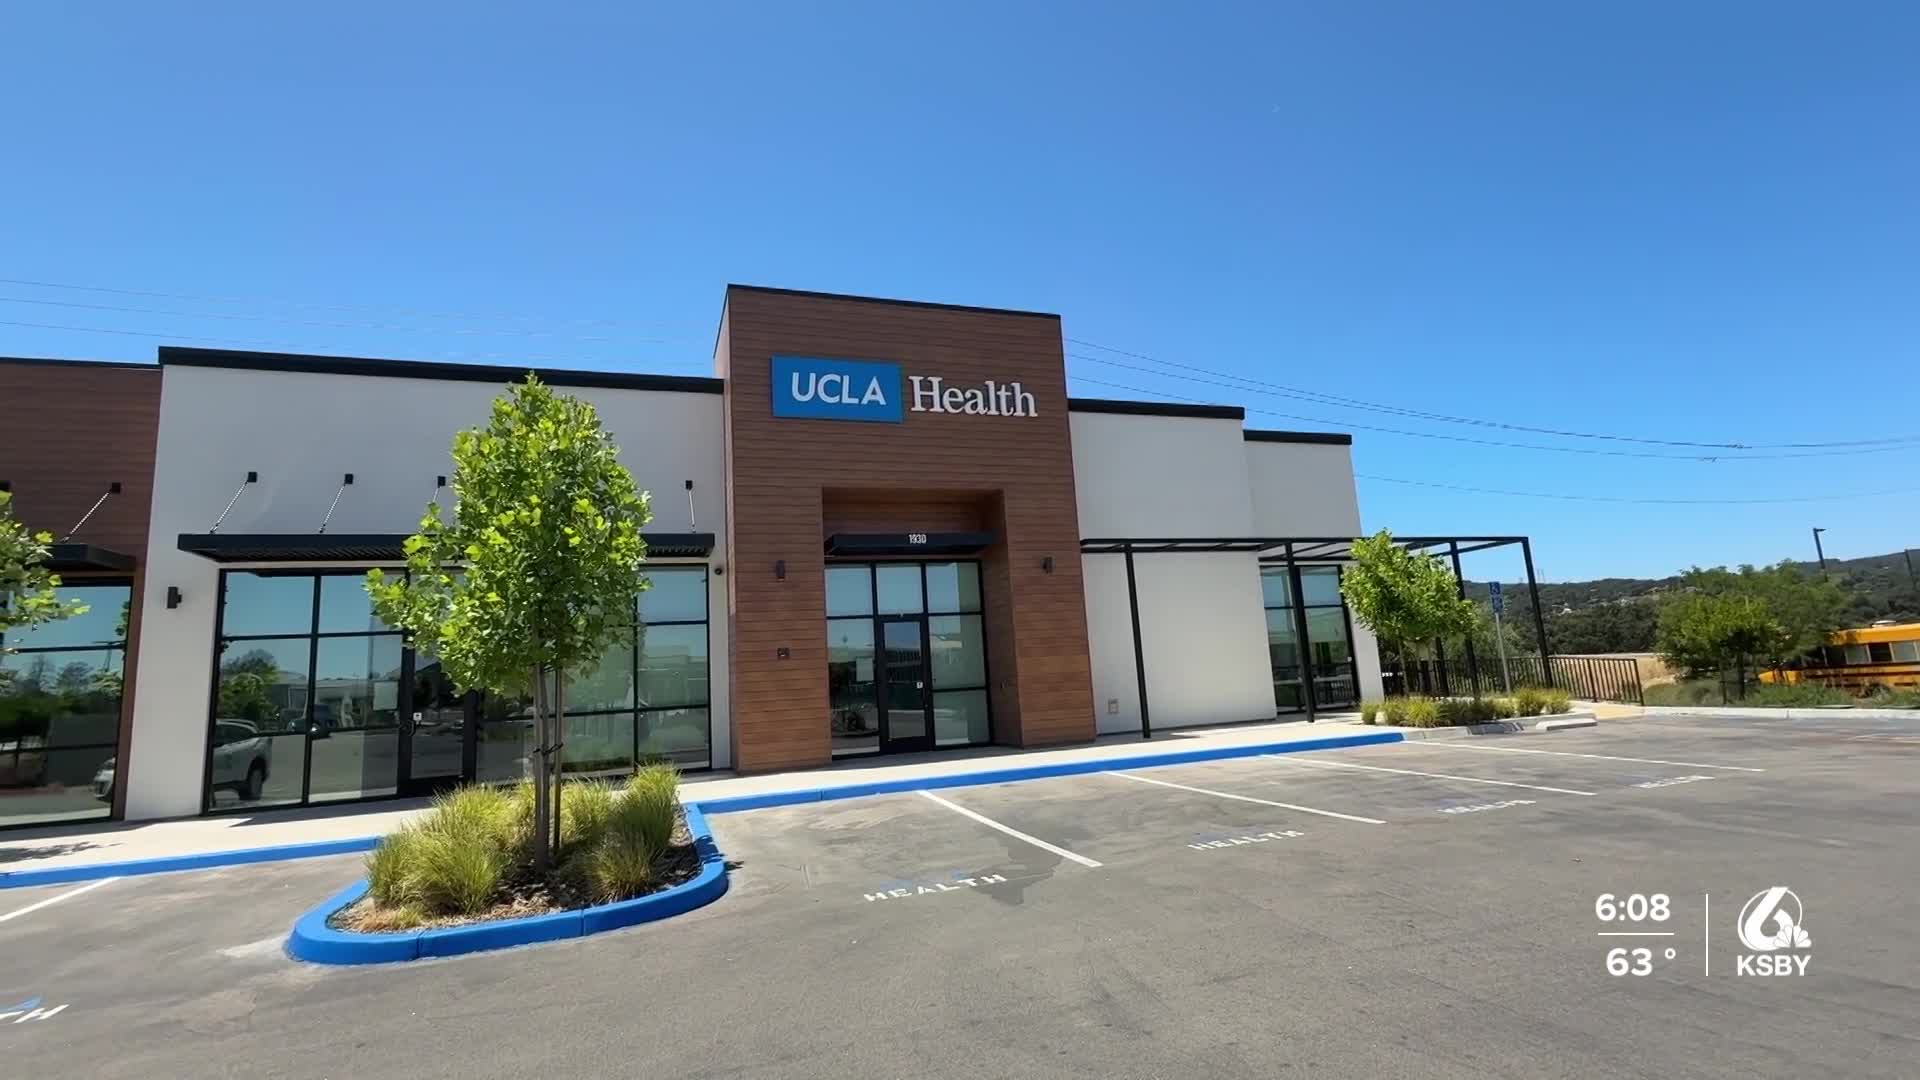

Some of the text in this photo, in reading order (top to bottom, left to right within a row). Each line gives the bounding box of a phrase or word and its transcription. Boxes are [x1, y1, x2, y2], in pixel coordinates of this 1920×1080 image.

[790, 371, 1039, 418] UCLA Health
[908, 534, 927, 544] 1930
[863, 874, 1008, 902] HEALTH
